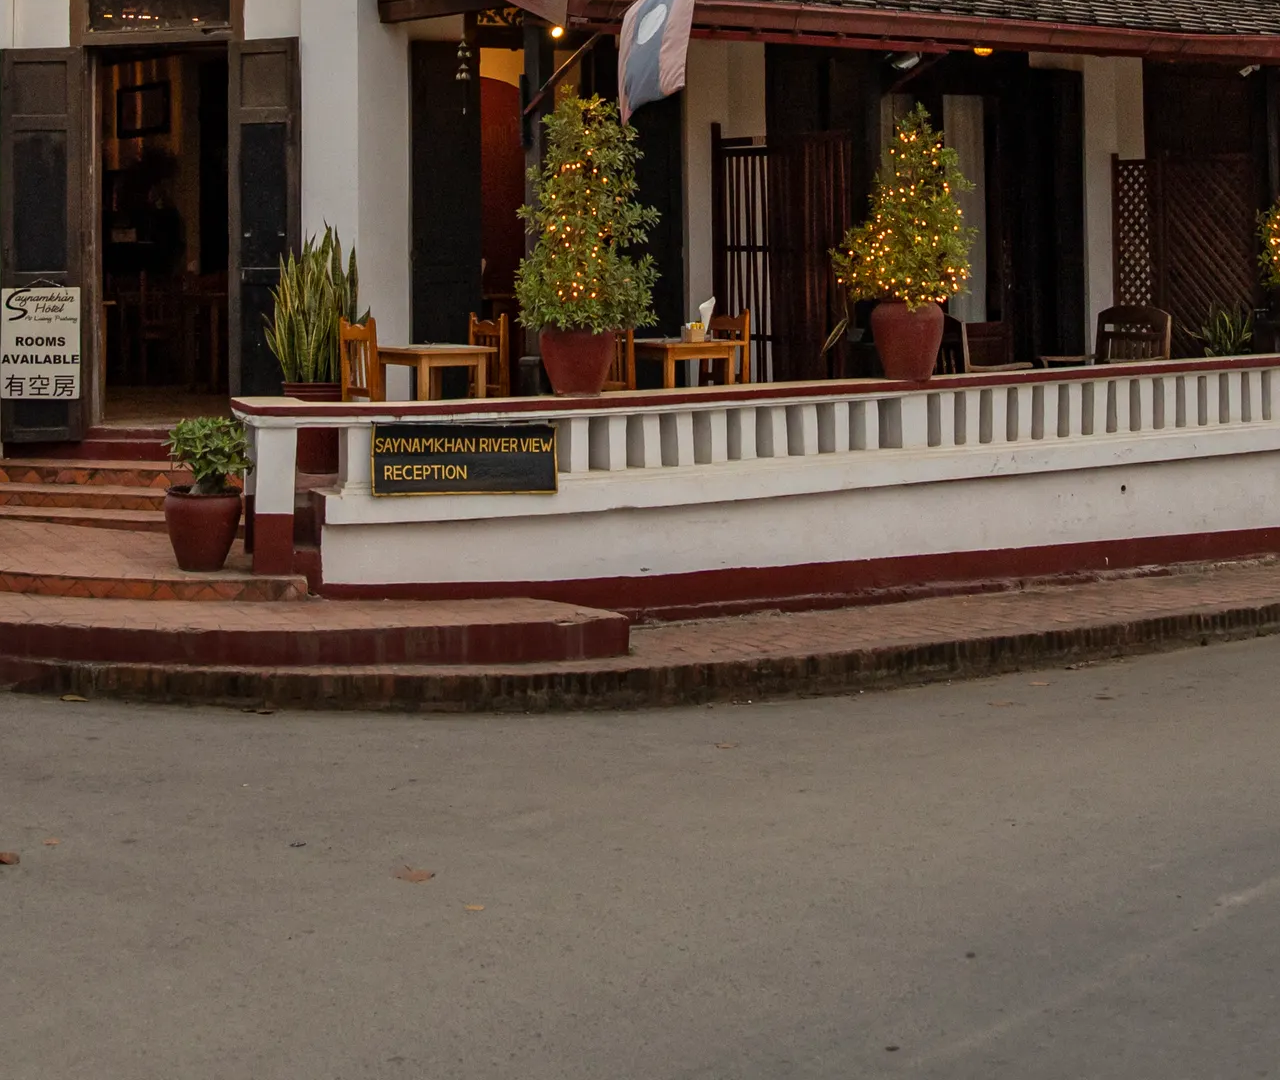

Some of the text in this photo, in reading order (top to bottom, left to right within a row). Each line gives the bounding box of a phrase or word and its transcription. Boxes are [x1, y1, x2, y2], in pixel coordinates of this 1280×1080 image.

[6, 289, 75, 321] Saynamkhan
[15, 336, 66, 347] ROOMS
[1, 354, 80, 365] AVAILABLE
[4, 374, 75, 397] 有空房
[375, 437, 553, 453] SAYNAMKHAN RIVER VIEW
[384, 465, 467, 480] RECEPTION
